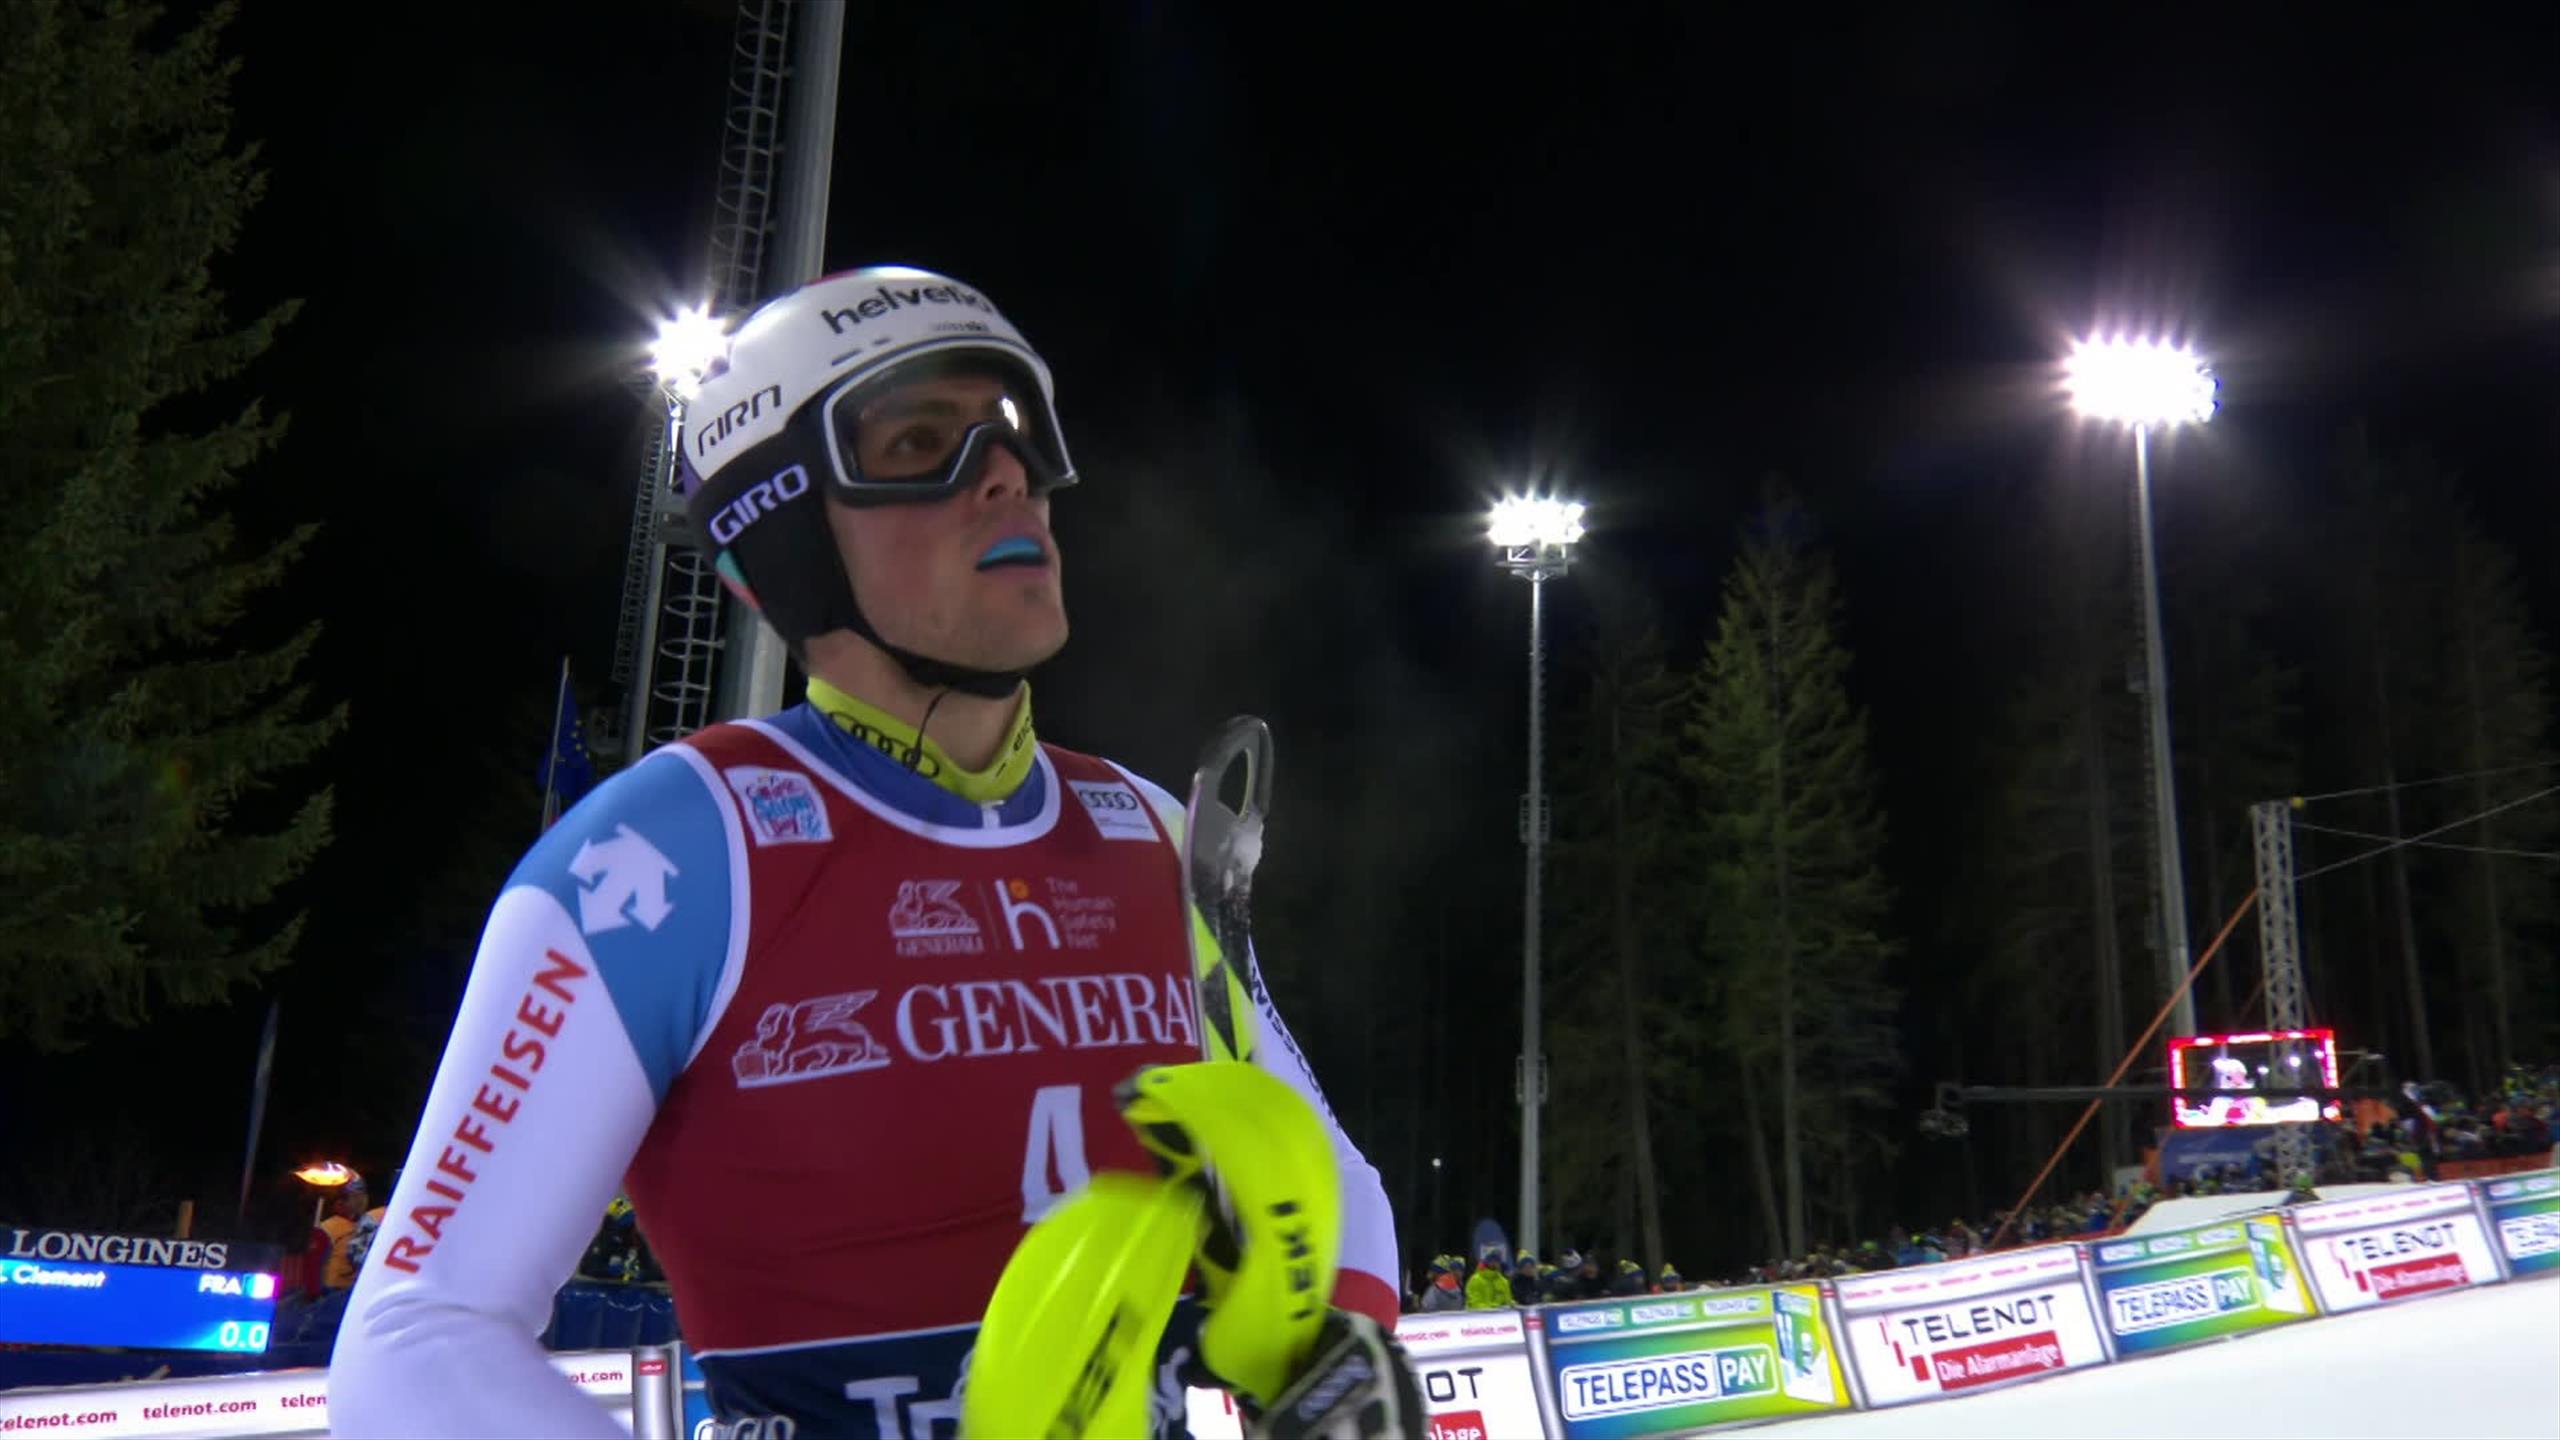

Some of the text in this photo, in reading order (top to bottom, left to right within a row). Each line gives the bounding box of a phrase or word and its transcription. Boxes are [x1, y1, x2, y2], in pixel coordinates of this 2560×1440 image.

[709, 463, 809, 545] GIRO
[895, 972, 1199, 1062] GENERA
[384, 947, 588, 1274] RAIFFEISEN
[9, 1230, 229, 1268] LONGINES
[2344, 1223, 2455, 1260] TELENOT
[199, 1274, 242, 1296] FRA
[2116, 1276, 2250, 1322] TELEPASS PAY
[220, 1321, 269, 1348] 0.0
[1902, 1294, 2055, 1345] TELENOT
[1425, 1367, 1483, 1402] OT
[1573, 1354, 1768, 1407] TELEPASS PAY
[0, 1411, 117, 1431] elenot.com
[143, 1399, 257, 1420] telenot.com
[1430, 1423, 1481, 1440] lage
